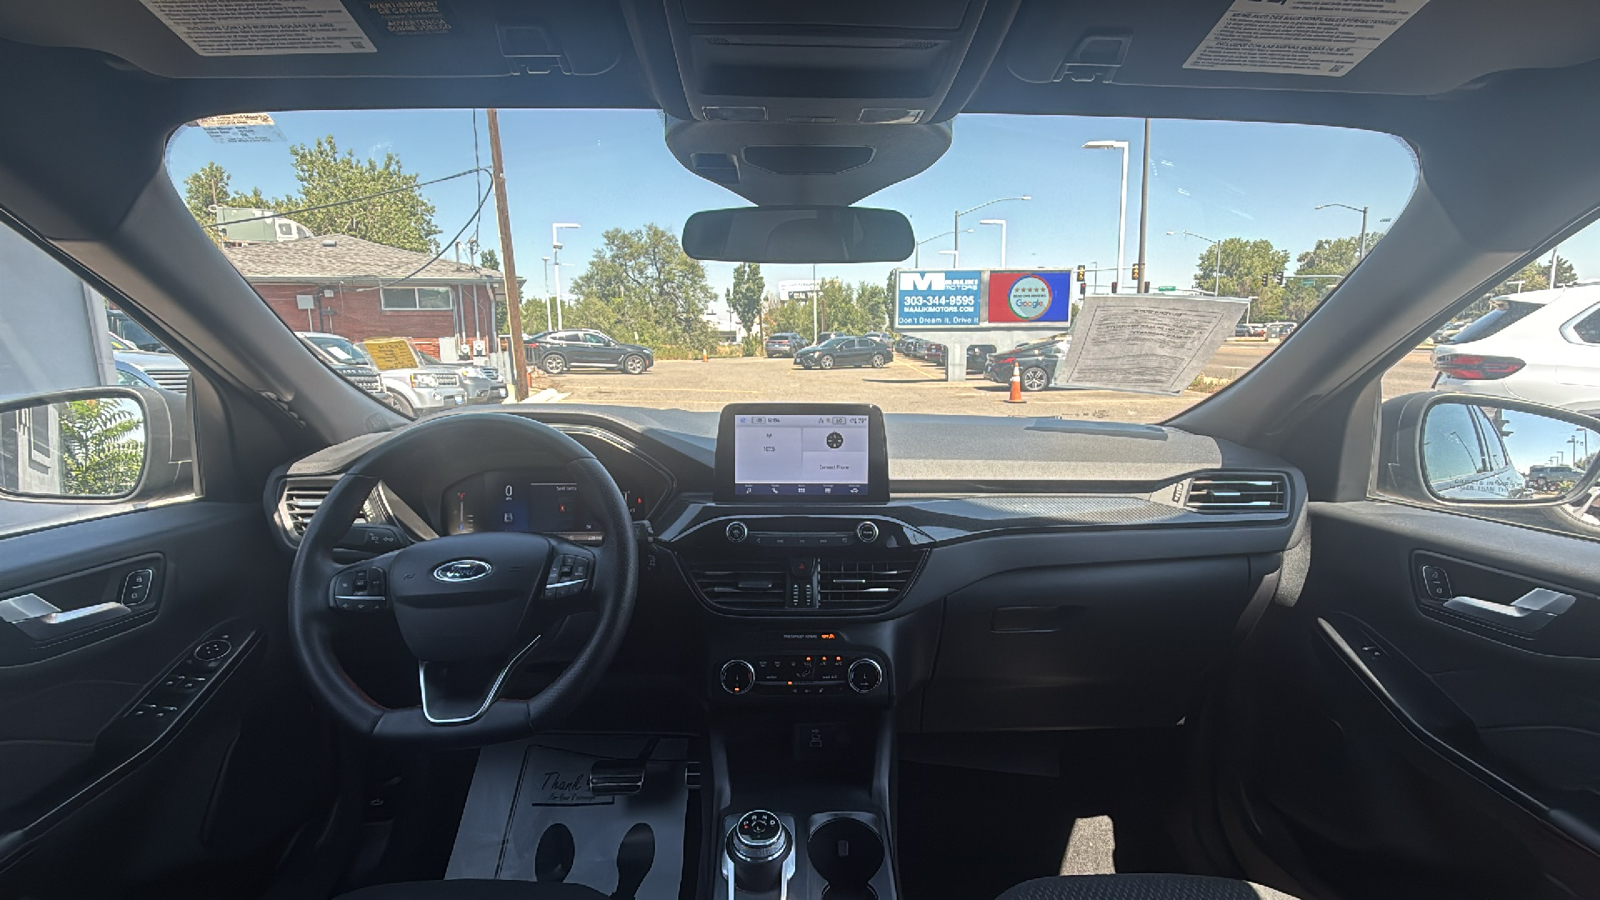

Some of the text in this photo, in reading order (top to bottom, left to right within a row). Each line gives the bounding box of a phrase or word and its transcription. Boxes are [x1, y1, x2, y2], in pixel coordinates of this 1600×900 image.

[904, 295, 975, 306] 303-344-9595
[1016, 299, 1043, 309] Google
[953, 316, 972, 324] Drive
[505, 485, 513, 497] 0
[541, 771, 584, 790] Thank
